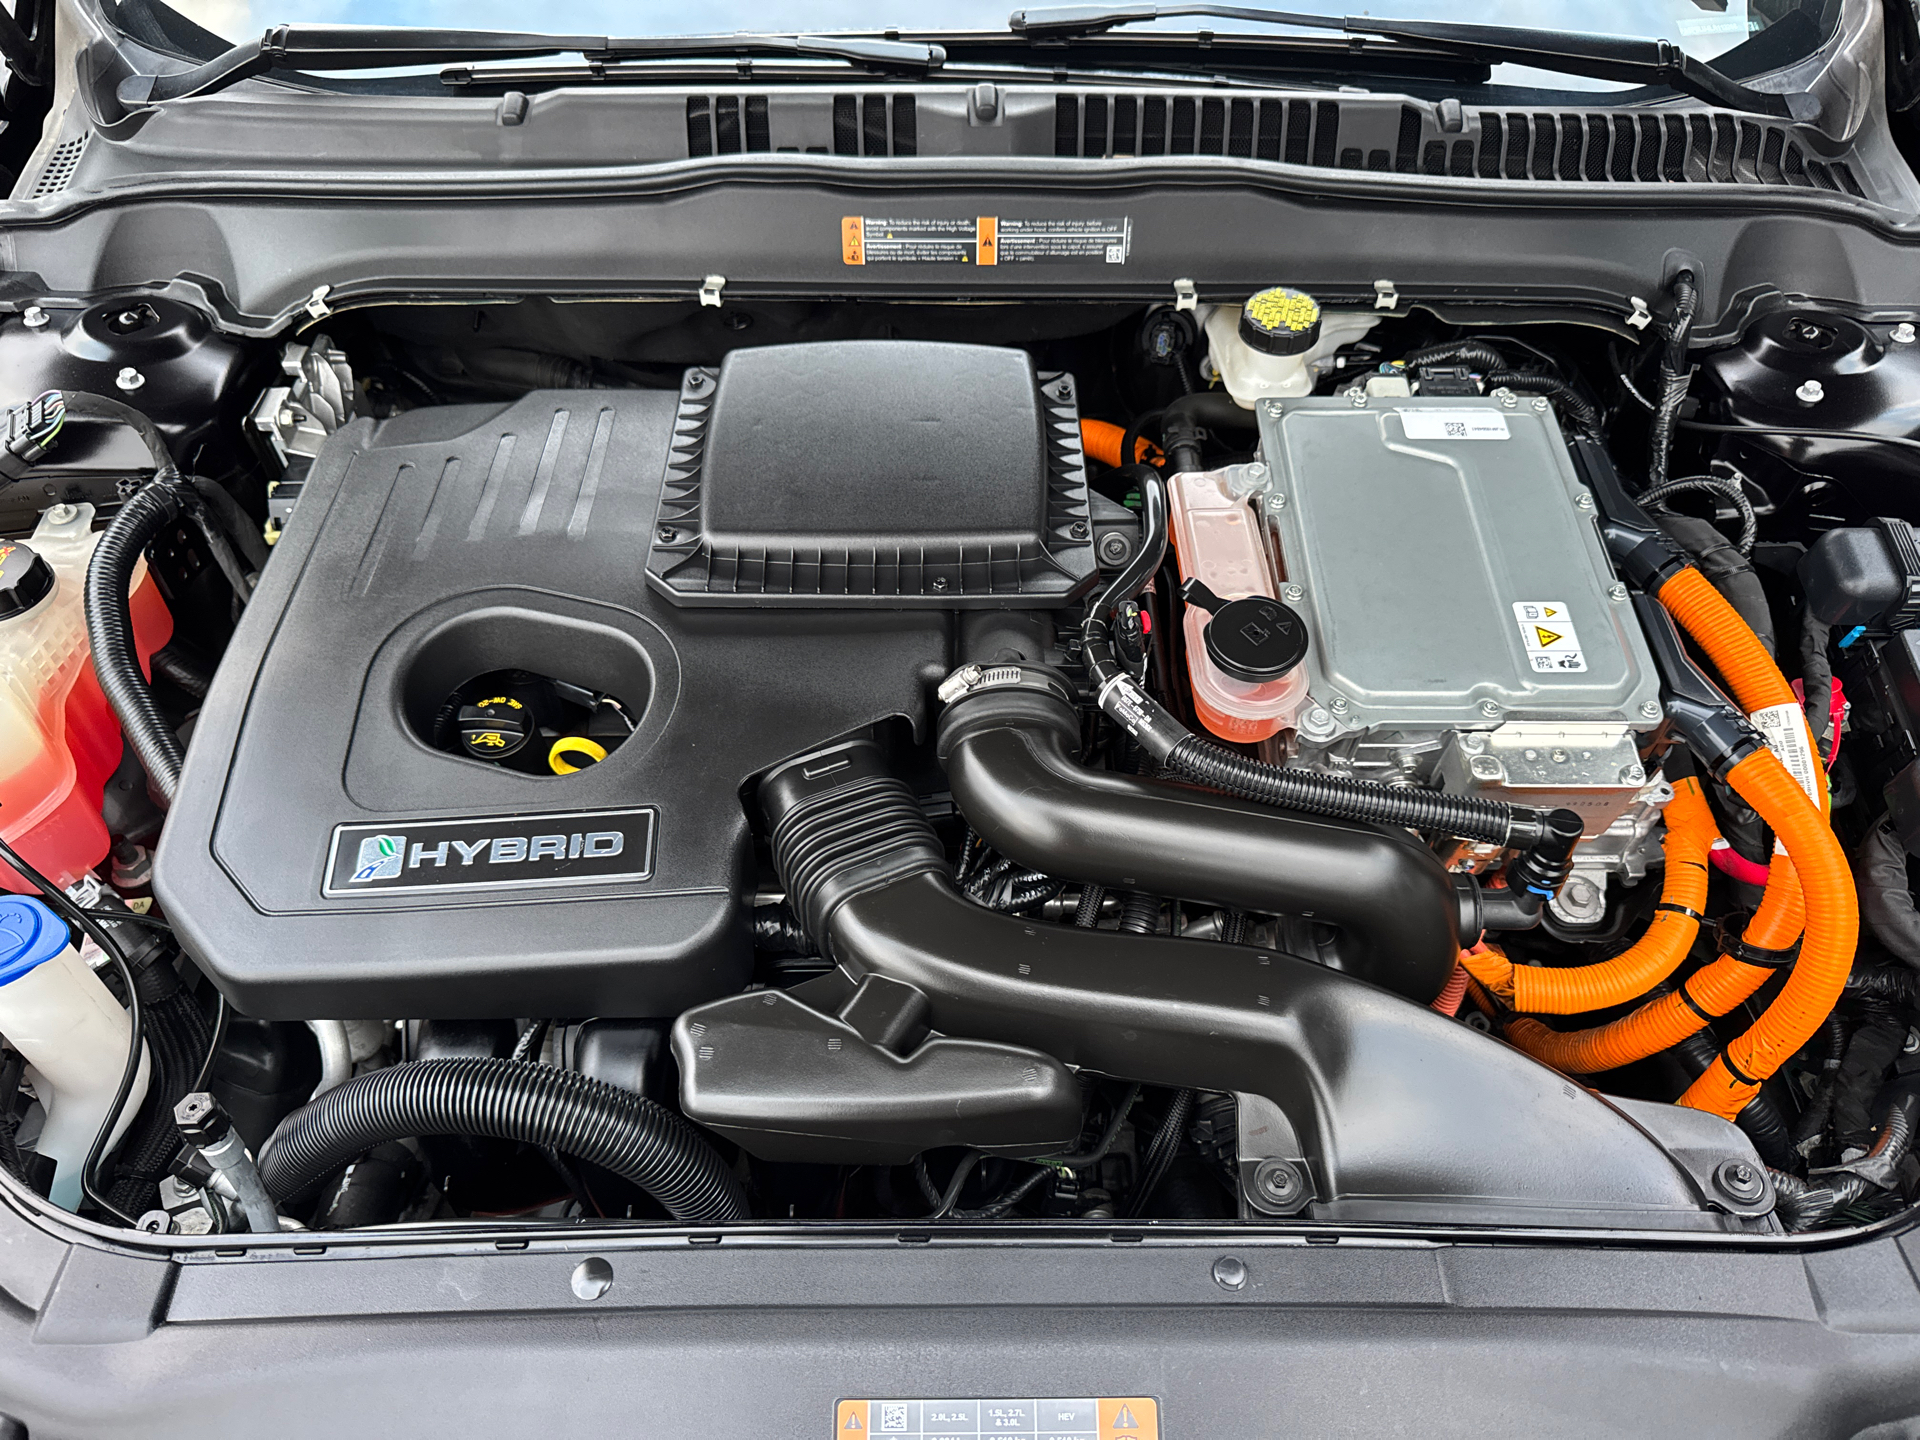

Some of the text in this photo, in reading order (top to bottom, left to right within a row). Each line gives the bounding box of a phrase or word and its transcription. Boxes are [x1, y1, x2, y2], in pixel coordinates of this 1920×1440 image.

[507, 698, 523, 710] SAE
[408, 831, 624, 869] HYBRID
[133, 901, 145, 910] DA
[1058, 1412, 1075, 1421] HEV
[995, 1418, 1020, 1427] & 3.0L
